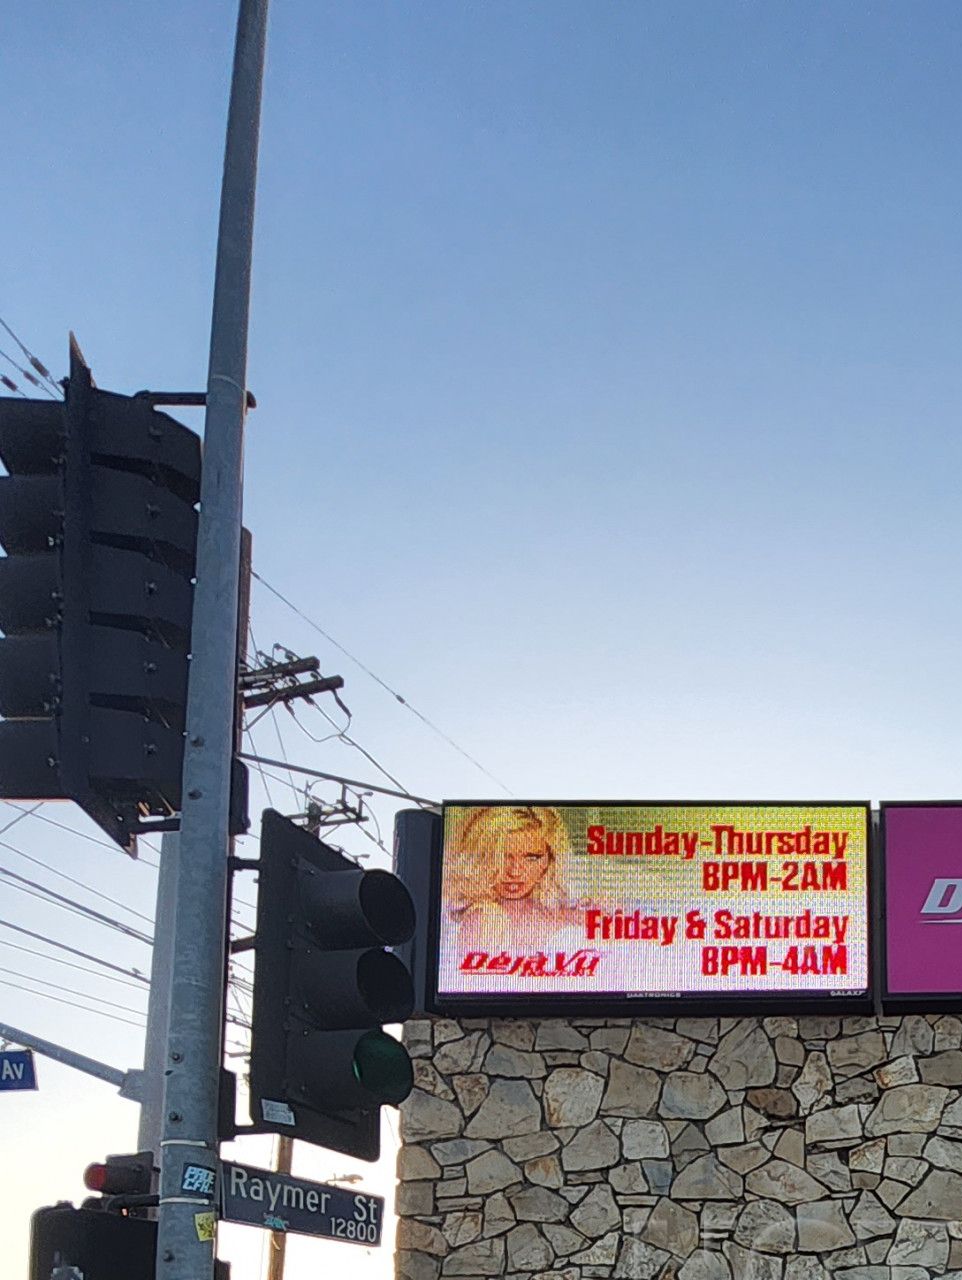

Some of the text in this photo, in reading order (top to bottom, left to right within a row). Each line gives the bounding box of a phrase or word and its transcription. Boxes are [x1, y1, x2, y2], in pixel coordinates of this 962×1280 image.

[586, 825, 849, 859] Sunday-Thursday
[702, 861, 848, 891] 8PM-2AM
[585, 909, 849, 946] Friday & Saturday
[702, 945, 848, 976] 8PM-4AM
[1, 1059, 24, 1081] Av
[230, 1167, 378, 1224] Raymer St
[329, 1217, 378, 1243] 12800
